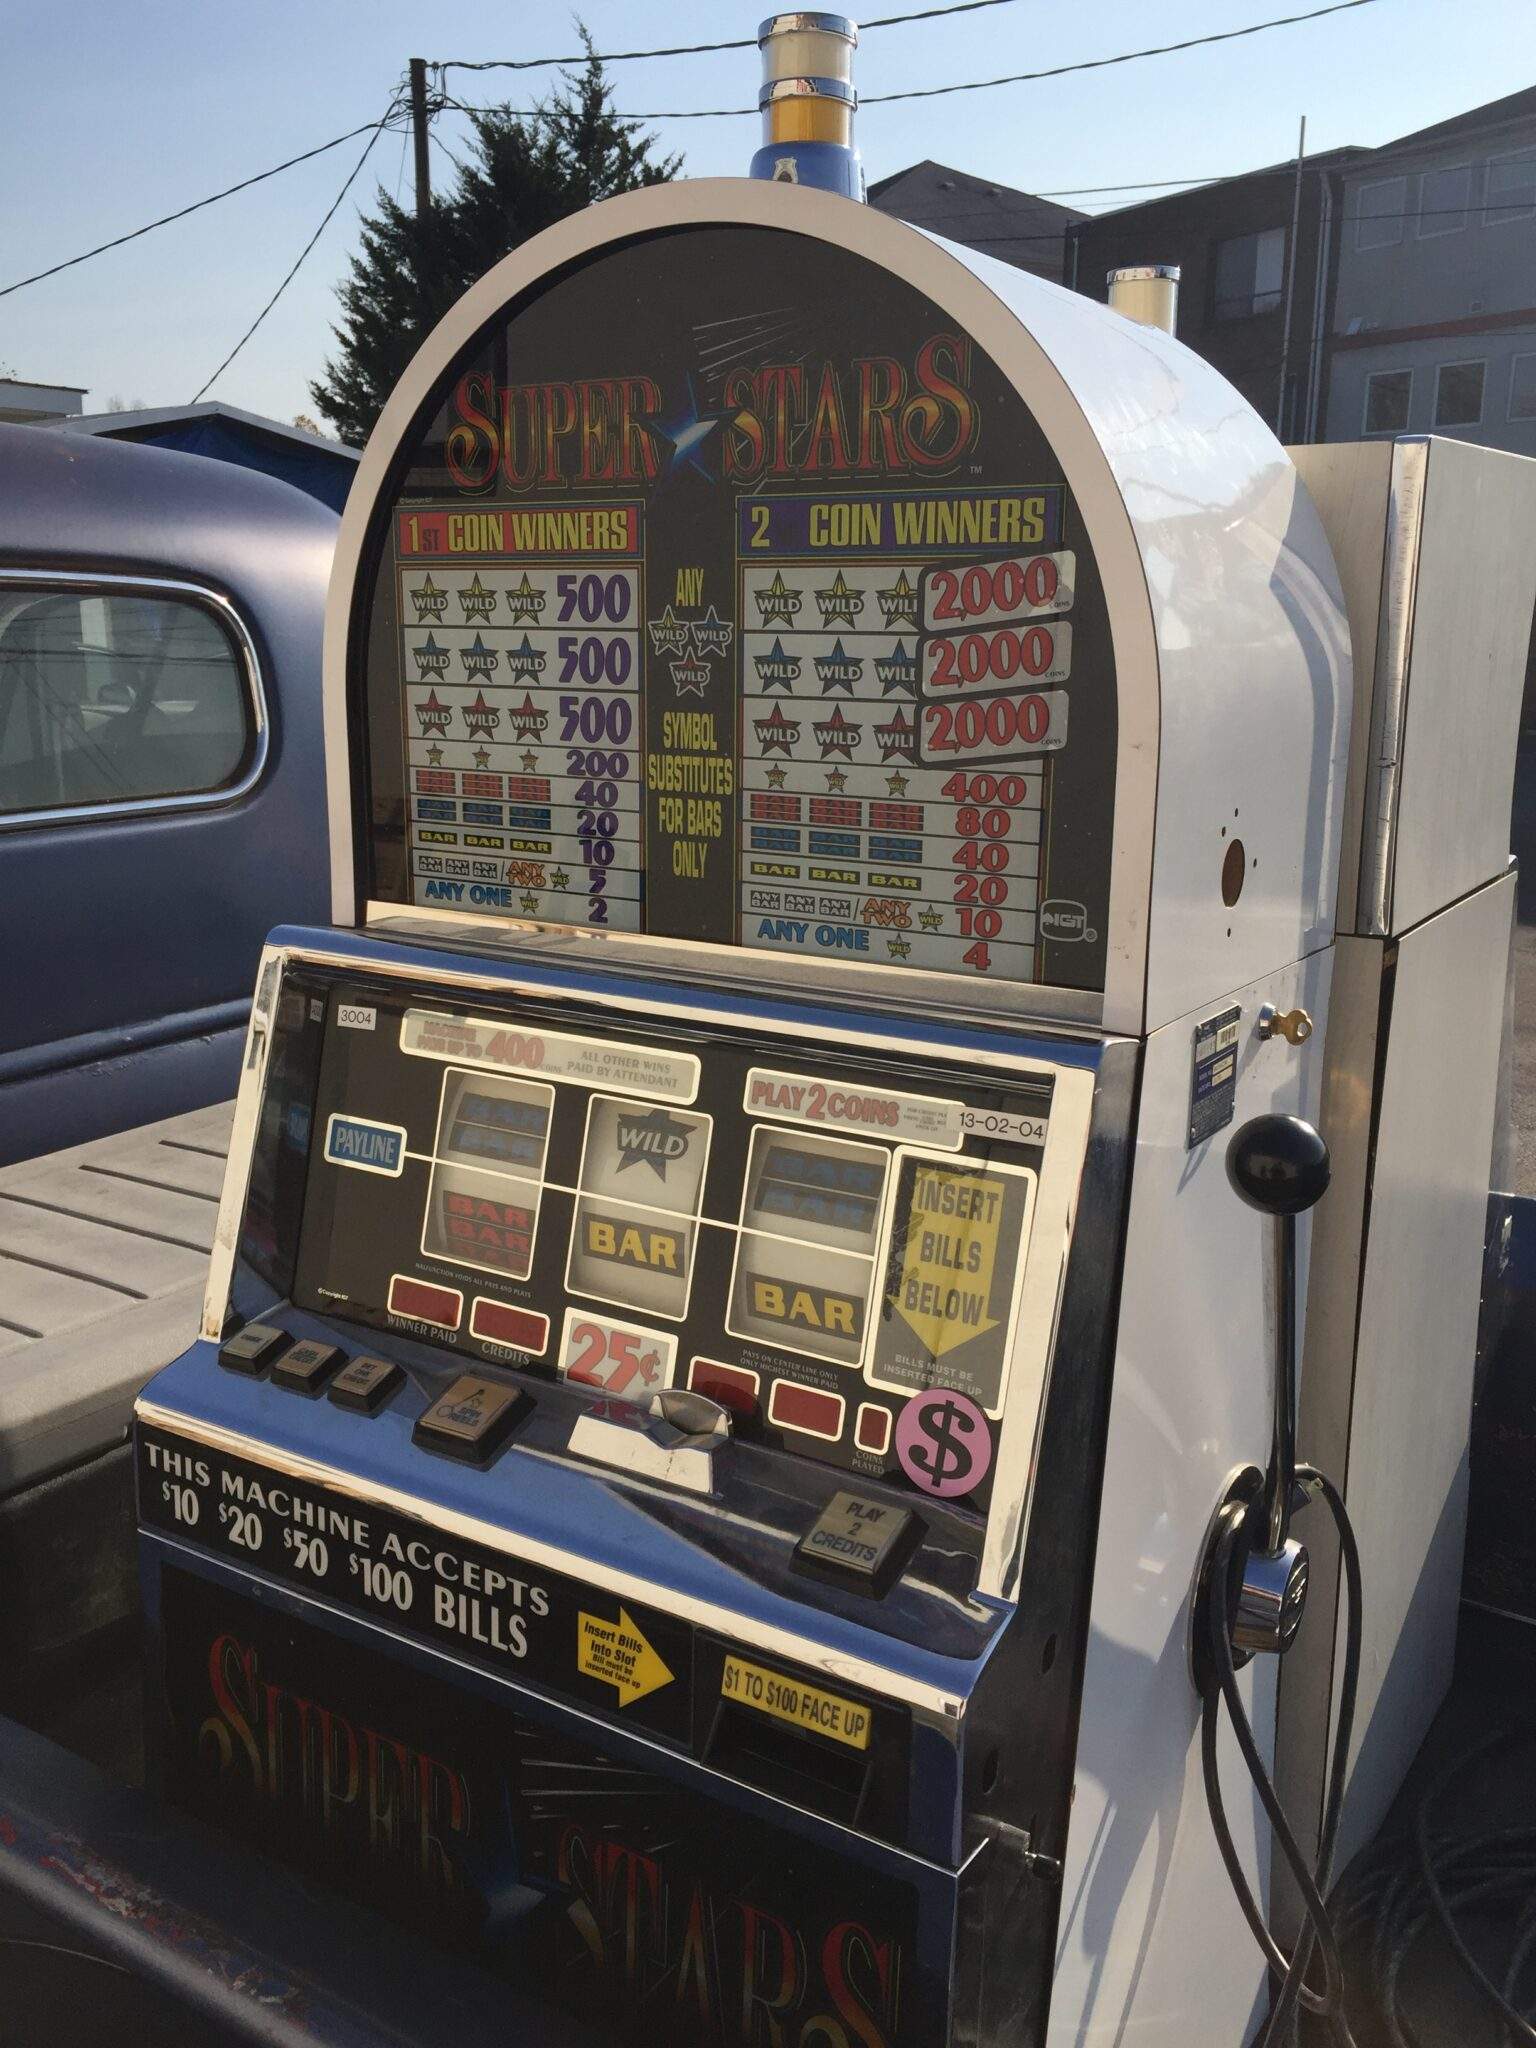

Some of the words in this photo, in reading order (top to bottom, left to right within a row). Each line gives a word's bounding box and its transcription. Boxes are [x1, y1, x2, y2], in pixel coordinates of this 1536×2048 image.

[447, 371, 659, 489] SUPER
[723, 333, 979, 478] STARS
[449, 511, 503, 552] COIN
[512, 510, 628, 552] WINNERS
[751, 506, 770, 547] 2
[810, 503, 881, 547] COIN
[894, 497, 1046, 545] WINNERS
[414, 598, 447, 610] WILD
[462, 598, 496, 610] WILD
[510, 598, 546, 611] WILD
[557, 574, 631, 623] 500
[676, 568, 704, 606] ANY
[759, 599, 800, 612] WILD
[820, 599, 862, 612] WILD
[654, 629, 685, 641] WILD
[696, 630, 729, 642] WILD
[416, 655, 449, 668] WILD
[463, 656, 497, 669] WILD
[510, 657, 545, 671] WILD
[558, 637, 631, 685] 500
[675, 670, 706, 682] WILD
[757, 665, 799, 678] WILD
[818, 667, 861, 680] WILD
[418, 711, 451, 724] WILD
[464, 714, 499, 727] WILD
[510, 716, 547, 729] WILD
[559, 696, 632, 745] 500
[663, 711, 718, 751] SYMBOL
[757, 729, 799, 742] WILD
[817, 731, 860, 745] WILD
[566, 750, 629, 779] 200
[648, 754, 733, 795] SUBSTITUTES
[574, 781, 618, 808] 40
[941, 773, 1027, 806] 400
[577, 809, 619, 837] 20
[659, 797, 684, 834] FOR
[688, 800, 722, 838] BARS
[955, 807, 1011, 838] 80
[421, 832, 455, 843] BAR
[467, 836, 501, 847] BAR
[512, 841, 549, 852] BAR
[579, 840, 615, 866] 10
[672, 840, 708, 879] ONLY
[952, 841, 1010, 873] 40
[475, 863, 496, 871] ANY
[506, 873, 546, 887] TWO
[588, 869, 607, 893] 5
[508, 861, 545, 875] ANY
[752, 892, 779, 900] ANY
[787, 895, 814, 904] ANY
[821, 899, 849, 908] ANY
[754, 864, 796, 876] BAR
[812, 869, 857, 882] BAR
[872, 875, 918, 888] BAR
[954, 874, 1008, 905] 20
[425, 880, 465, 901] ANY
[470, 885, 512, 907] ONE
[588, 897, 608, 923] 2
[751, 900, 779, 909] BAR
[786, 903, 813, 913] BAR
[820, 907, 850, 916] BAR
[864, 897, 911, 914] ANY
[860, 911, 912, 928] TWO
[920, 916, 944, 925] WILD
[956, 908, 1002, 938] 10
[1054, 913, 1084, 928] IGT
[757, 919, 809, 943] ANY
[815, 925, 870, 951] ONE
[888, 943, 911, 952] WILD
[963, 942, 991, 970] 4
[341, 1009, 372, 1025] 3004
[486, 1031, 546, 1070] 400
[581, 1050, 600, 1063] ALL
[603, 1054, 640, 1070] OTHER
[643, 1061, 672, 1074] WINS
[567, 1061, 595, 1075] PAID
[598, 1067, 612, 1078] BY
[612, 1069, 680, 1089] ATTENDANT
[752, 1080, 806, 1110] PLAY
[805, 1083, 828, 1120] 2
[827, 1092, 900, 1127] COINS
[959, 1112, 1044, 1138] 13-02-04
[335, 1126, 396, 1164] PAYLINE
[620, 1126, 685, 1156] WILD
[449, 1196, 528, 1229] BAR
[917, 1177, 1001, 1224] INSERT
[589, 1220, 677, 1269] BAR
[920, 1231, 982, 1273] BILLS
[473, 1277, 484, 1286] ALL
[754, 1281, 856, 1335] BAR
[904, 1282, 985, 1327] BELOW
[387, 1314, 427, 1336] WINNER
[430, 1327, 457, 1344] PAID
[481, 1342, 530, 1365] CREDITS
[567, 1322, 661, 1394] 25¢
[743, 1349, 760, 1360] PAYS
[761, 1353, 774, 1363] ON
[774, 1356, 801, 1370] CENTER
[801, 1363, 816, 1373] LINE
[816, 1367, 839, 1380] ONLY
[895, 1354, 925, 1370] BILLS
[926, 1363, 956, 1379] MUST
[959, 1371, 974, 1382] BE
[740, 1358, 761, 1371] ONLY
[791, 1370, 819, 1386] WINNER
[820, 1377, 839, 1390] PAID
[884, 1363, 935, 1384] INSERTED
[937, 1376, 965, 1393] FACE
[967, 1384, 982, 1396] UP
[855, 1451, 884, 1465] COINS
[908, 1400, 976, 1488] $
[852, 1458, 885, 1475] PLAYED
[845, 1501, 886, 1523] PLAY
[144, 1441, 211, 1487] THIS
[221, 1470, 370, 1549] MACHINE
[382, 1533, 550, 1617] ACCEPTS
[849, 1522, 861, 1536] 2
[811, 1531, 878, 1562] CREDITS
[161, 1482, 200, 1526] $10
[218, 1503, 262, 1551] $20
[283, 1527, 329, 1577] $50
[348, 1552, 413, 1611] $100
[433, 1584, 529, 1659] BILLS
[584, 1621, 616, 1644] Insert
[618, 1633, 643, 1654] Bills
[590, 1640, 613, 1659] Into
[615, 1649, 637, 1667] Slot
[592, 1654, 607, 1666] Bill
[606, 1660, 624, 1672] must
[624, 1666, 633, 1676] be
[585, 1661, 614, 1679] inserted
[614, 1671, 631, 1684] face
[631, 1679, 641, 1690] up
[724, 1664, 740, 1691] $1
[743, 1672, 763, 1699] TO
[766, 1682, 798, 1714] $100
[800, 1693, 840, 1731] FACE
[844, 1710, 865, 1738] UP
